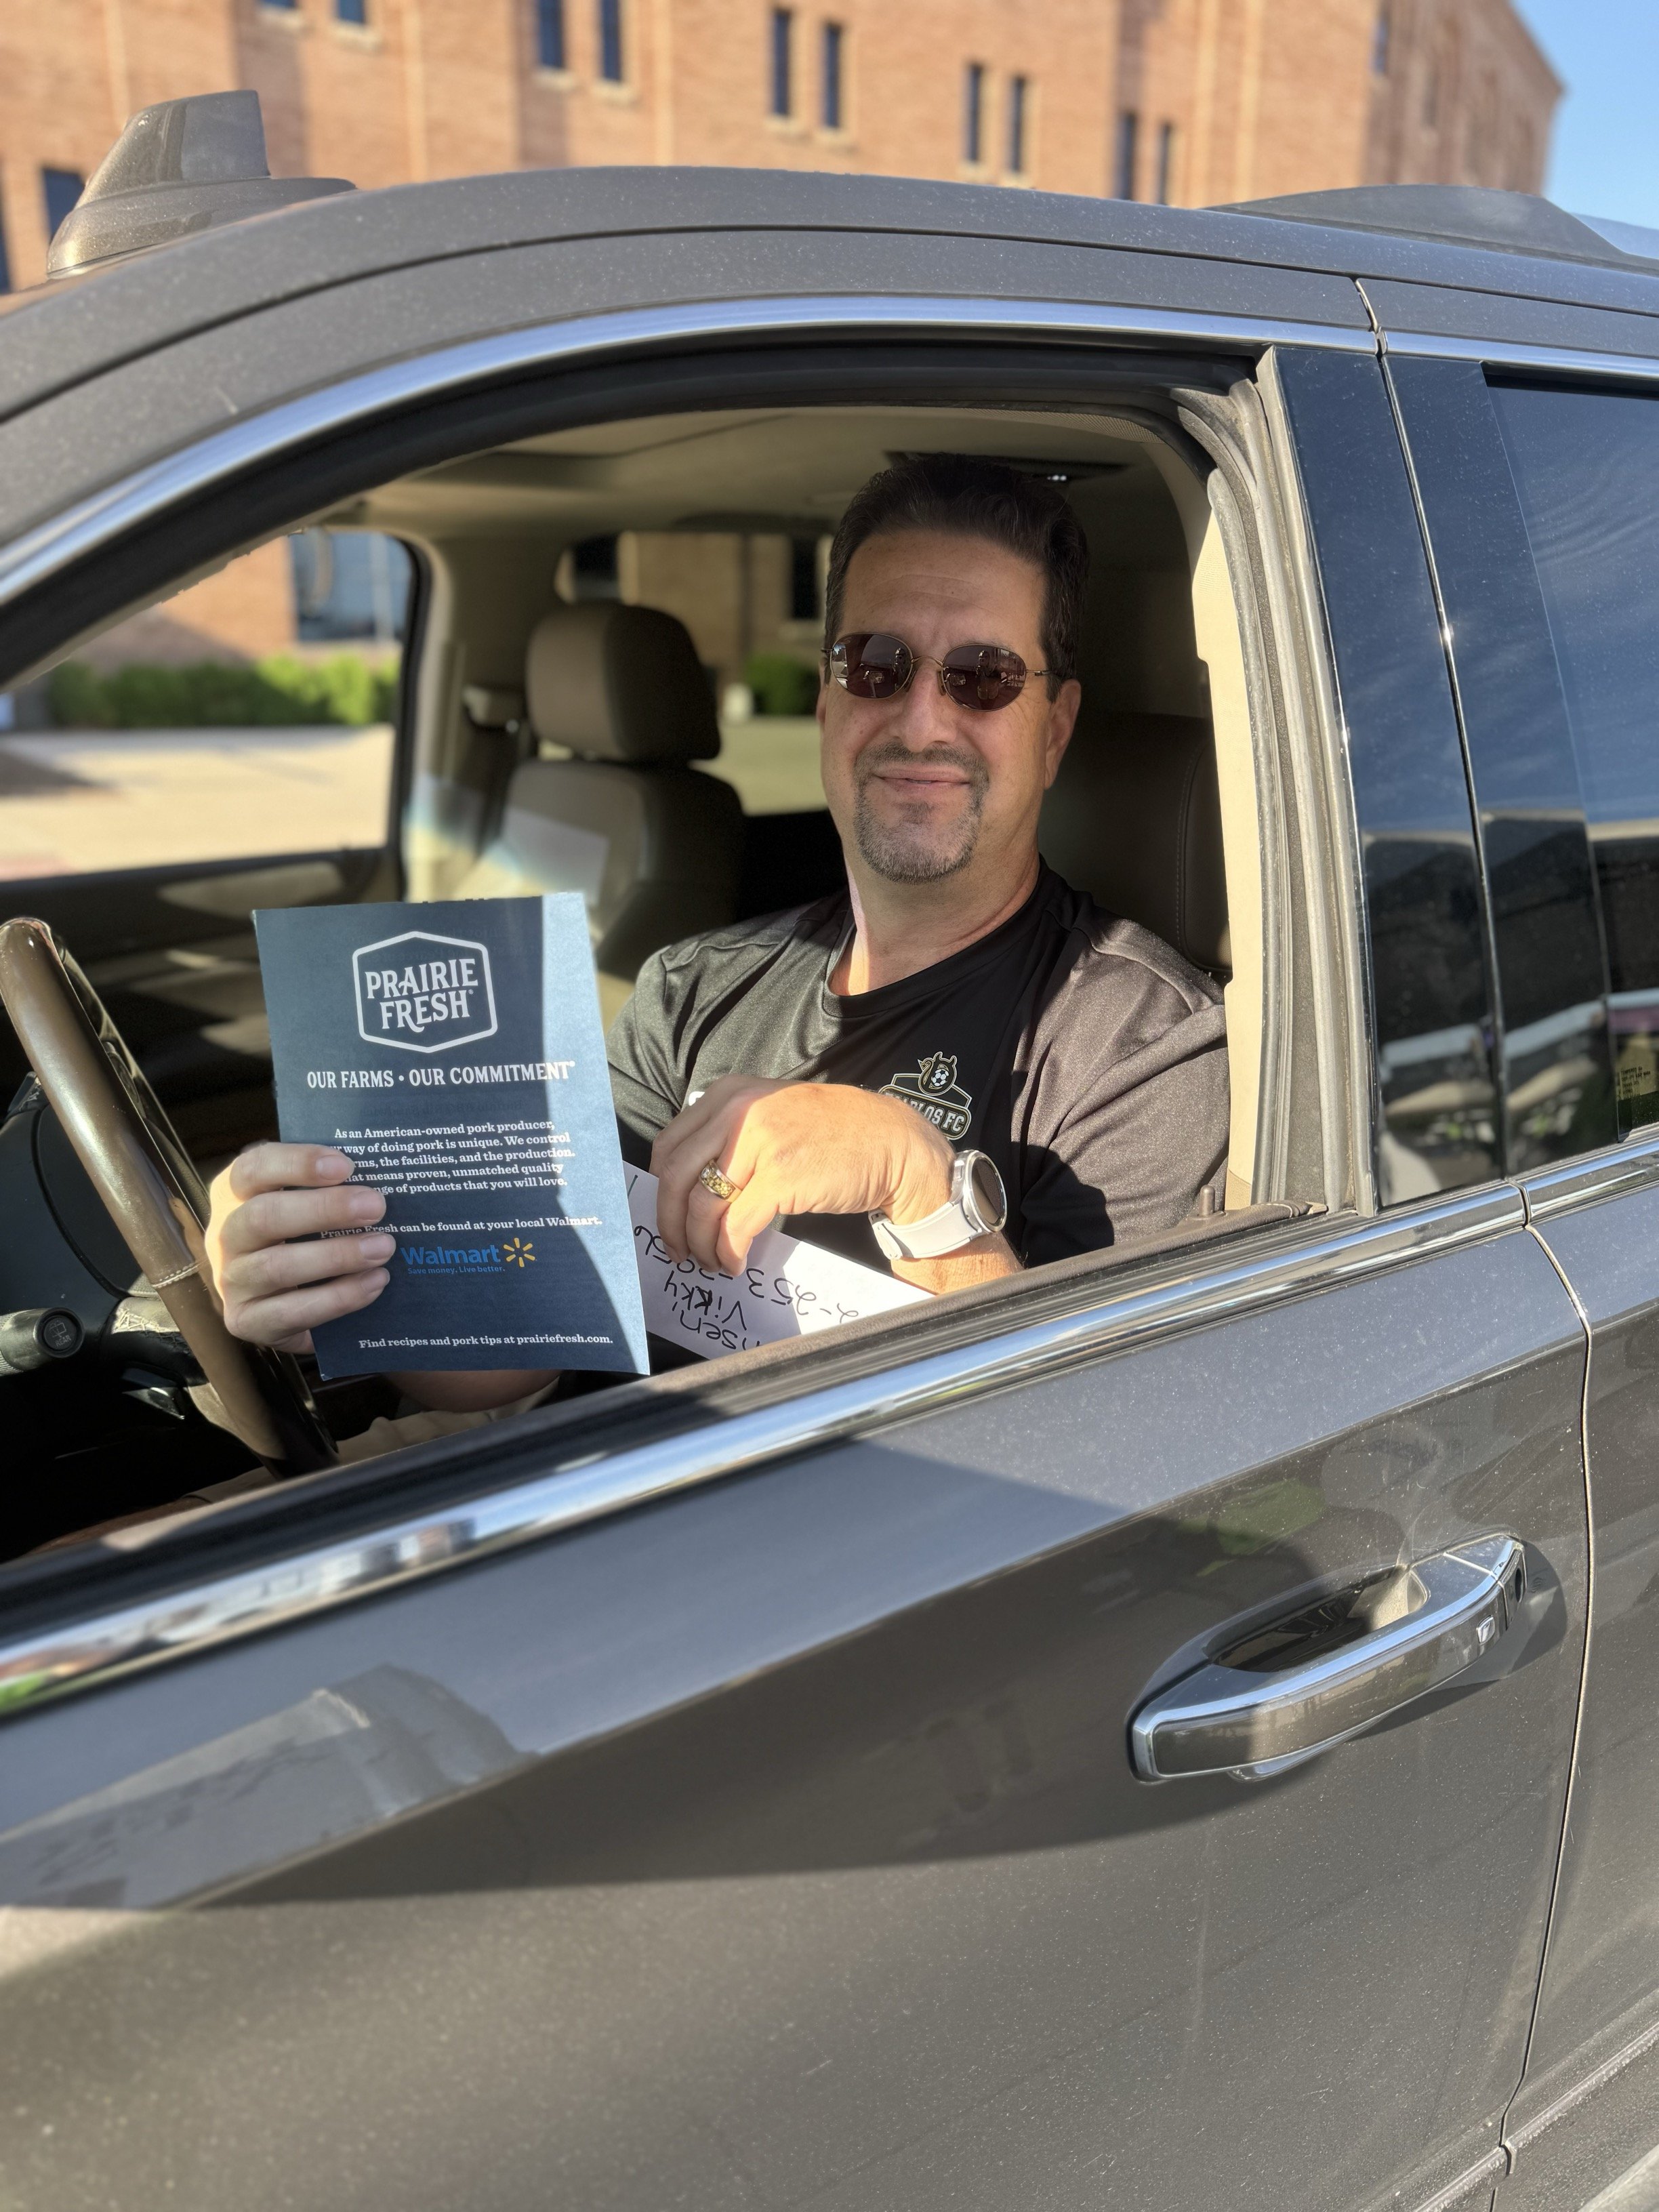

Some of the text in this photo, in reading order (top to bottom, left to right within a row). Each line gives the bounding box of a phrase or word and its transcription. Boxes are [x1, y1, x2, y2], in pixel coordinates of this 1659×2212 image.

[365, 958, 478, 999] PRAIRIE
[380, 989, 470, 1033] FRESH
[307, 1061, 570, 1088] OUR FARMS OUR COMMITMENT
[335, 1120, 555, 1139] As an American-owned pork producer,
[941, 1111, 965, 1132] FC
[343, 1145, 365, 1155] way
[367, 1143, 380, 1152] of
[381, 1142, 414, 1153] doing
[416, 1139, 444, 1151] pork
[445, 1139, 457, 1149] is
[458, 1138, 503, 1149] unique.
[504, 1136, 525, 1145] We
[526, 1132, 571, 1145] control
[354, 1148, 575, 1168] rms, the facilities, and the production.
[366, 1172, 404, 1181] means
[405, 1169, 451, 1180] proven,
[452, 1164, 519, 1177] unmatched
[520, 1162, 564, 1174] quality
[396, 1184, 408, 1193] of
[409, 1181, 462, 1194] products
[463, 1180, 488, 1189] that
[489, 1180, 512, 1191] you
[513, 1177, 537, 1187] will
[539, 1176, 567, 1186] love.
[364, 1223, 398, 1233] Fresh
[400, 1224, 421, 1232] can
[422, 1223, 436, 1231] be
[437, 1221, 472, 1231] found
[474, 1221, 485, 1229] at
[487, 1221, 514, 1231] your
[516, 1218, 544, 1227] local
[546, 1216, 602, 1227] Walmart.
[400, 1244, 501, 1265] Walmart
[477, 1265, 506, 1273] better.
[56, 1334, 72, 1347] REAR
[359, 1334, 613, 1348] Find recipes and pork tips at prairiefresh.com.
